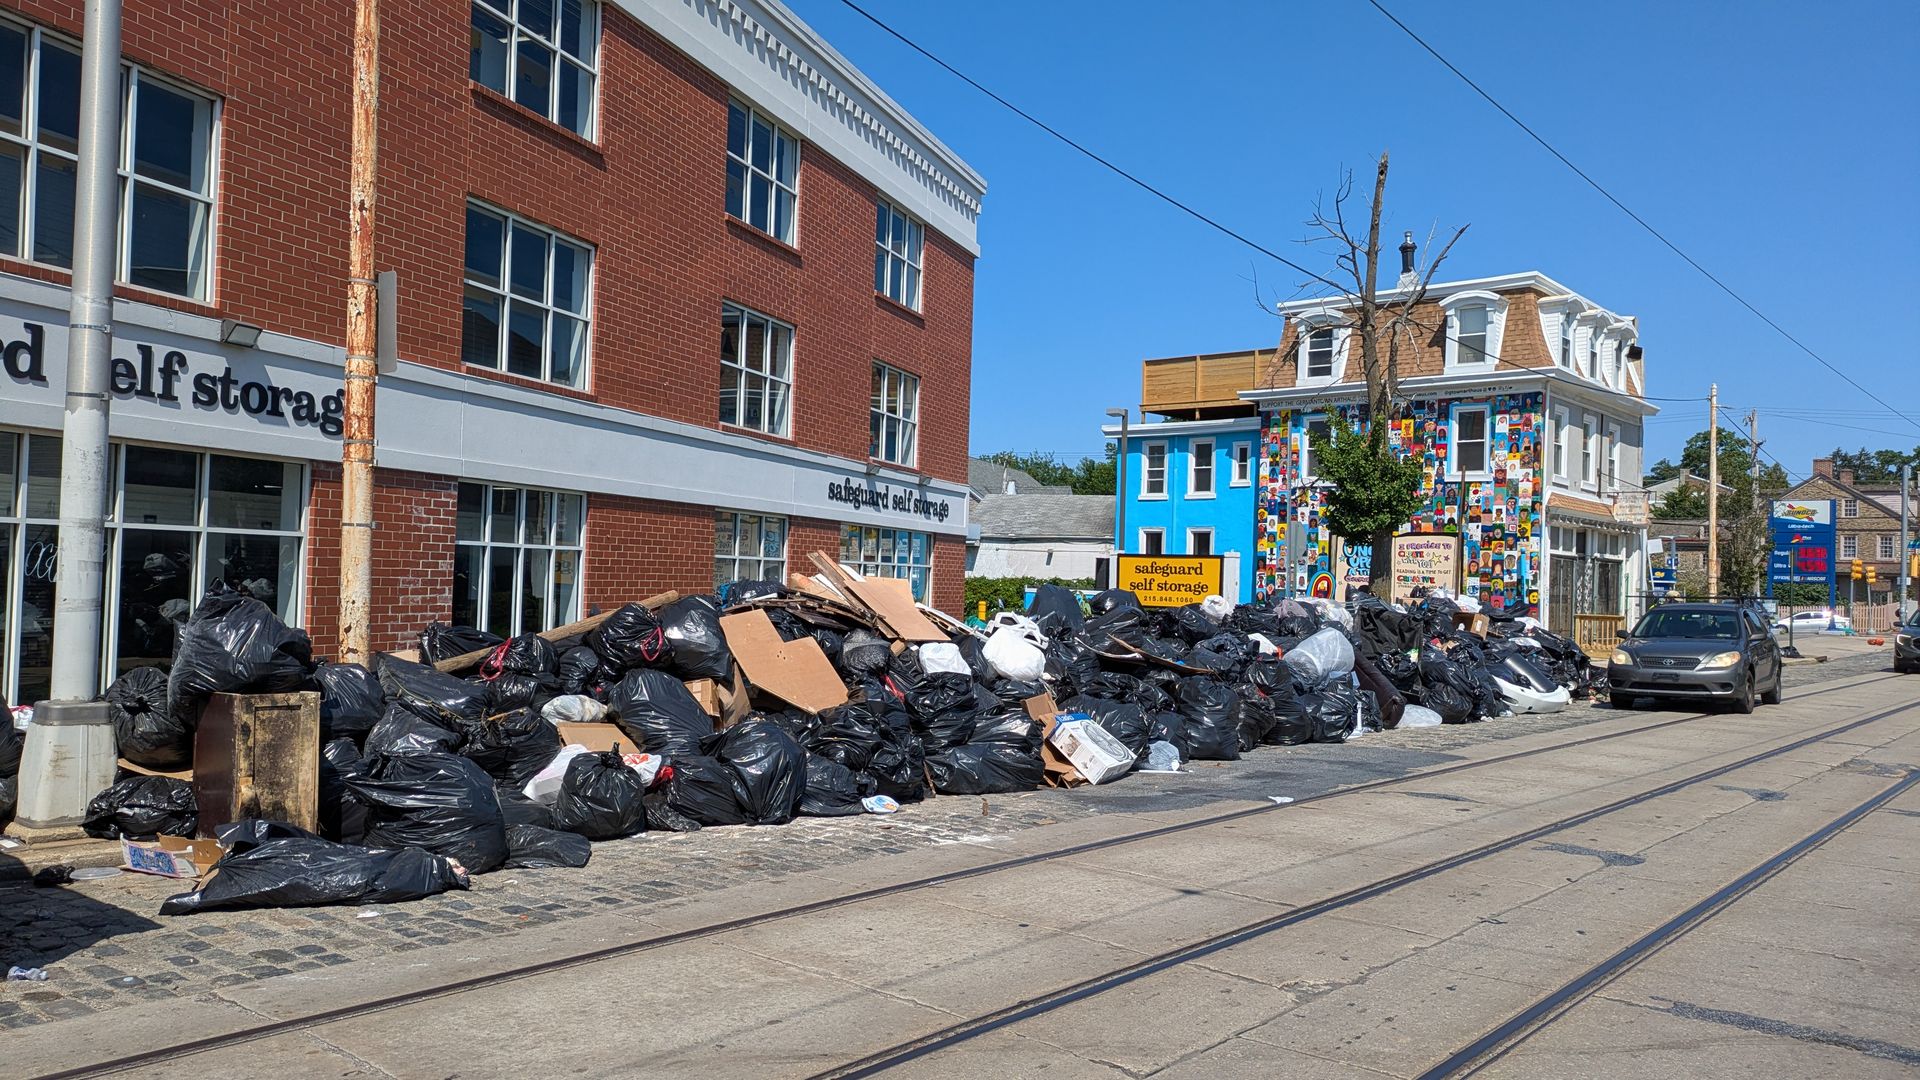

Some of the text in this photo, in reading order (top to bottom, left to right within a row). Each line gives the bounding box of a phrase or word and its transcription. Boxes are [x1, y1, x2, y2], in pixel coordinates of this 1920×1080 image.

[111, 343, 187, 402] elf
[192, 366, 344, 436] storag
[828, 477, 949, 523] safeguard self storage
[1134, 561, 1203, 577] safeguard
[1129, 578, 1209, 596] self storage
